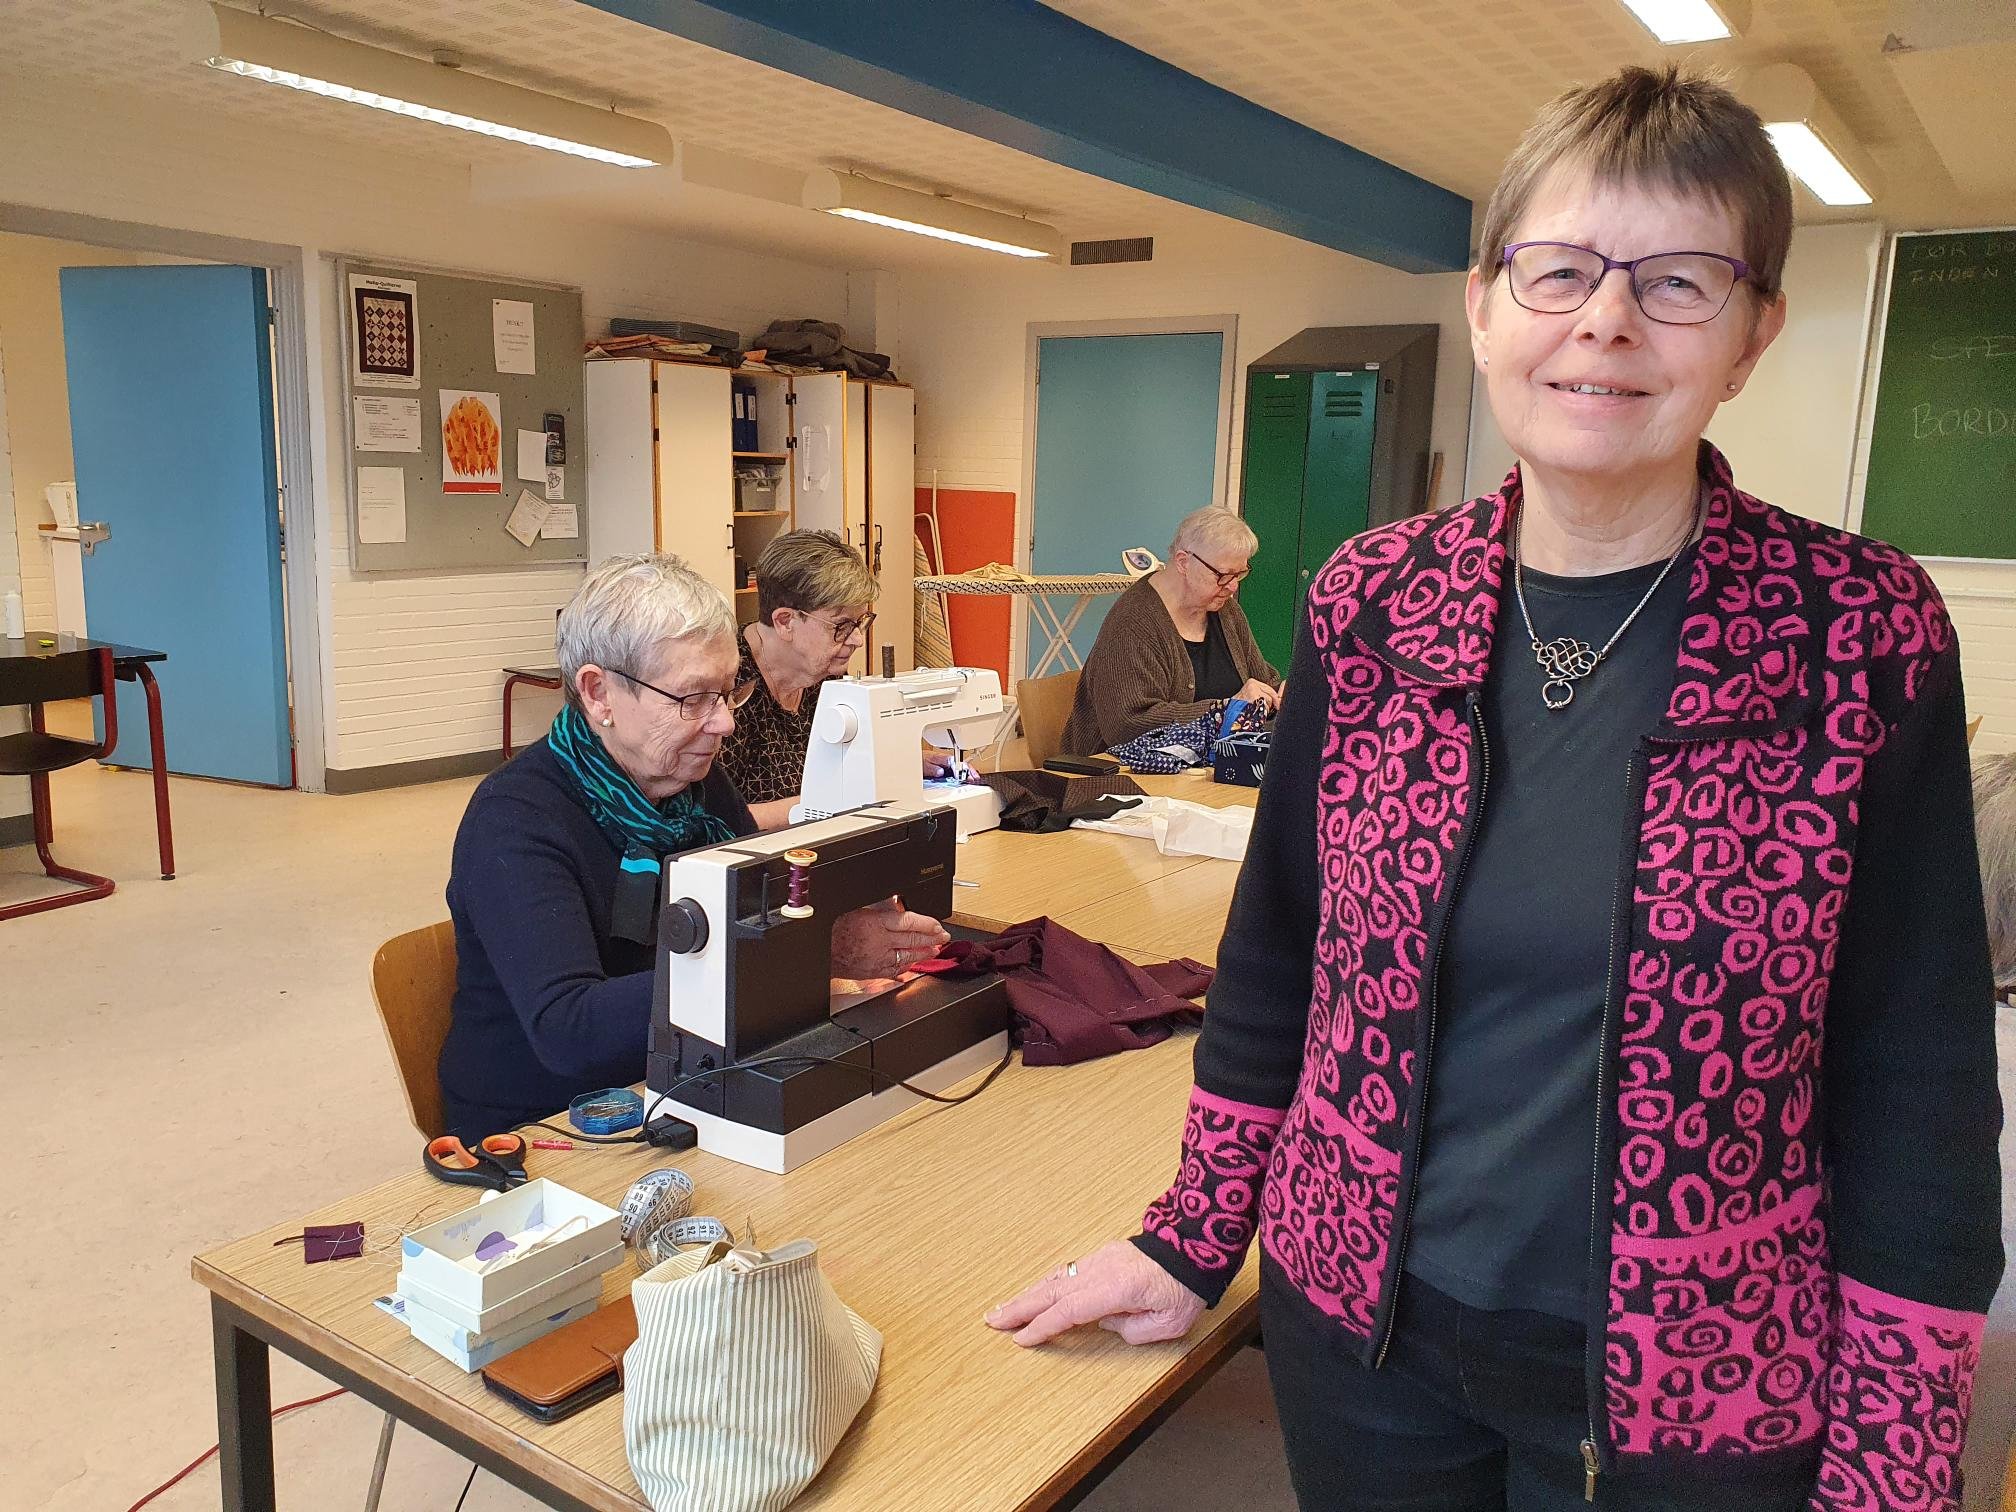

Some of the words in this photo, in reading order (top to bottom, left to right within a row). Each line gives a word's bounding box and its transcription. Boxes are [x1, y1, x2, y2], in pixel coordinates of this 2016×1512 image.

[629, 1203, 639, 1213] 90
[623, 1215, 632, 1223] 91
[676, 1228, 684, 1238] 93
[688, 1225, 696, 1235] 92
[700, 1225, 707, 1233] 91
